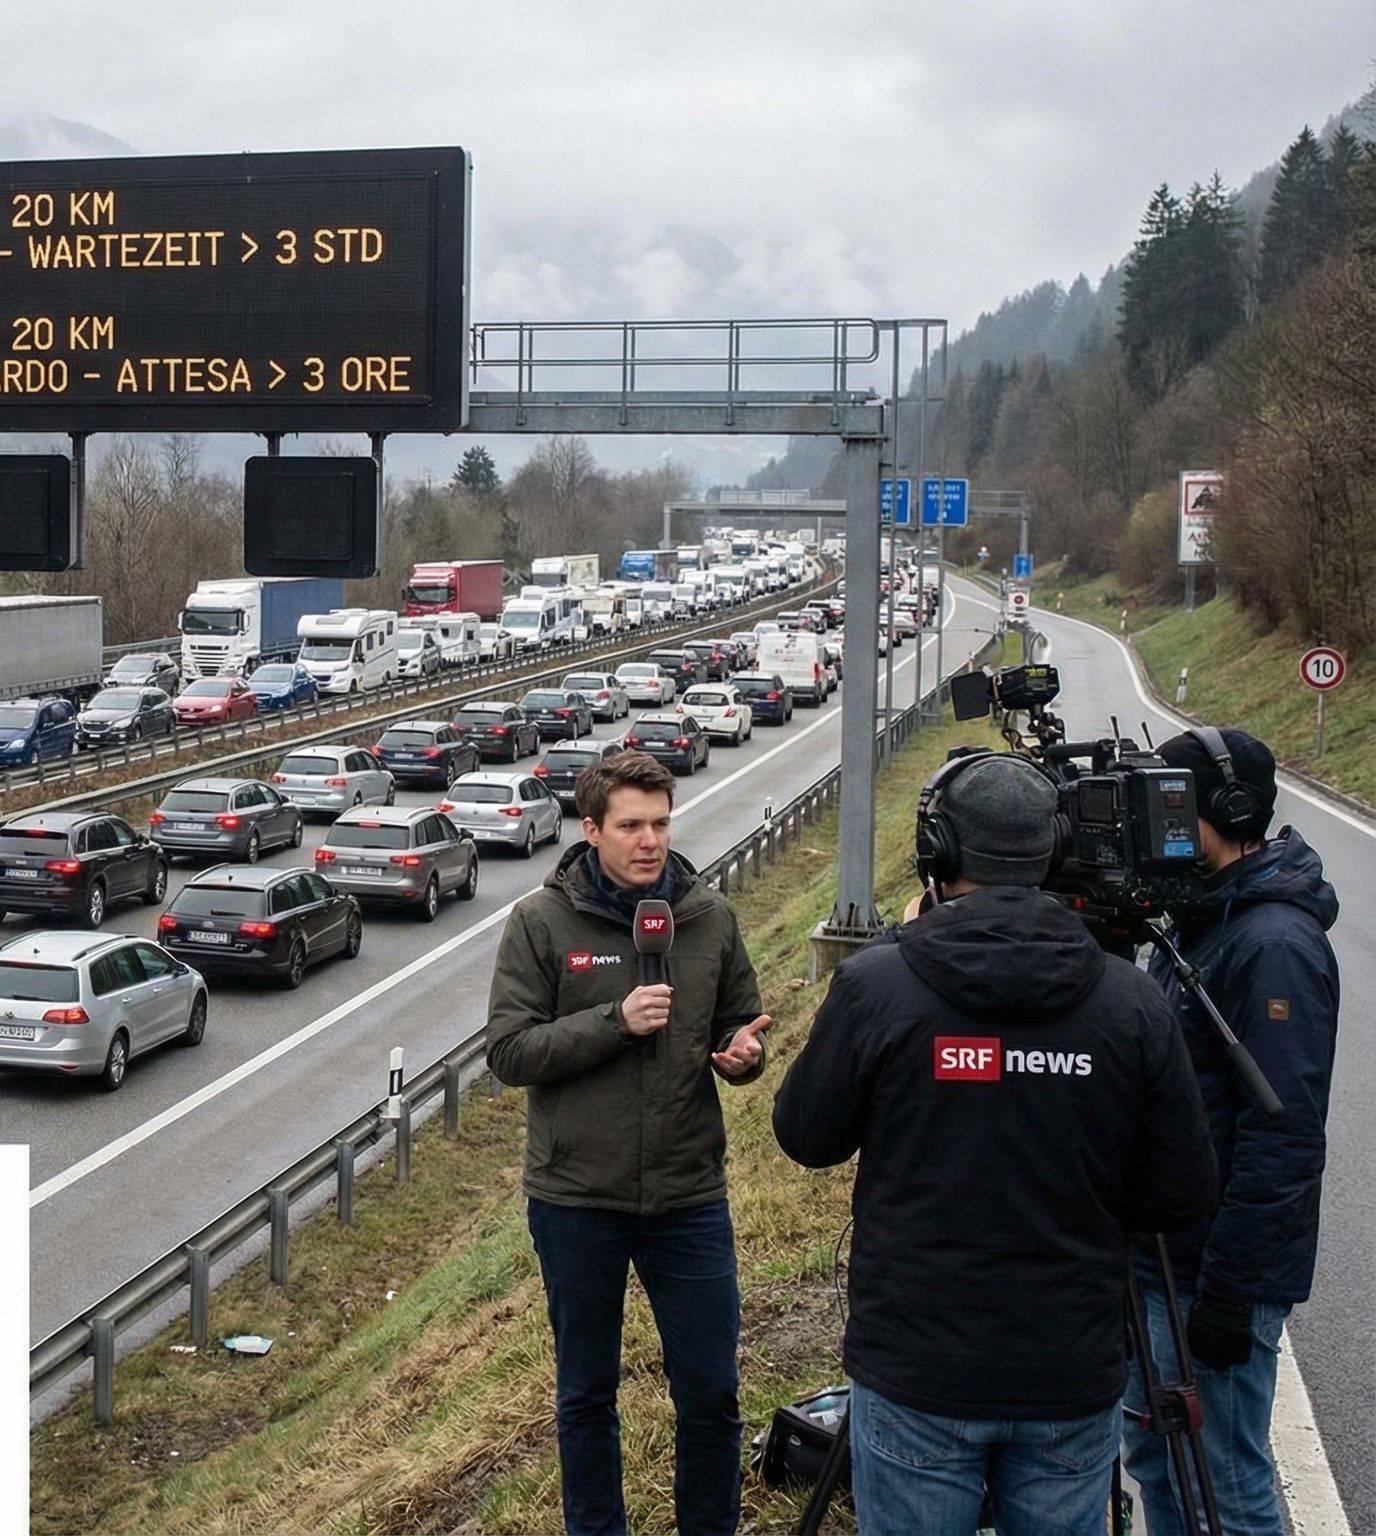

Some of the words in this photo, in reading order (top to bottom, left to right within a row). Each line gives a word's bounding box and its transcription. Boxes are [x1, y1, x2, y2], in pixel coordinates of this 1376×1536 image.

[12, 193, 54, 228] 20
[69, 191, 115, 226] KM
[28, 230, 225, 268] WARTEZEIT
[243, 234, 258, 261] >
[276, 228, 298, 265] 3
[313, 227, 384, 264] STD
[11, 316, 54, 351] 20
[69, 315, 115, 350] KM
[116, 357, 253, 393] ATTESA
[269, 361, 287, 388] >
[302, 356, 326, 392] 3
[340, 355, 411, 393] ORE
[1312, 658, 1334, 678] 10
[592, 955, 622, 966] news
[941, 1047, 993, 1070] SRF
[1006, 1049, 1092, 1076] news
